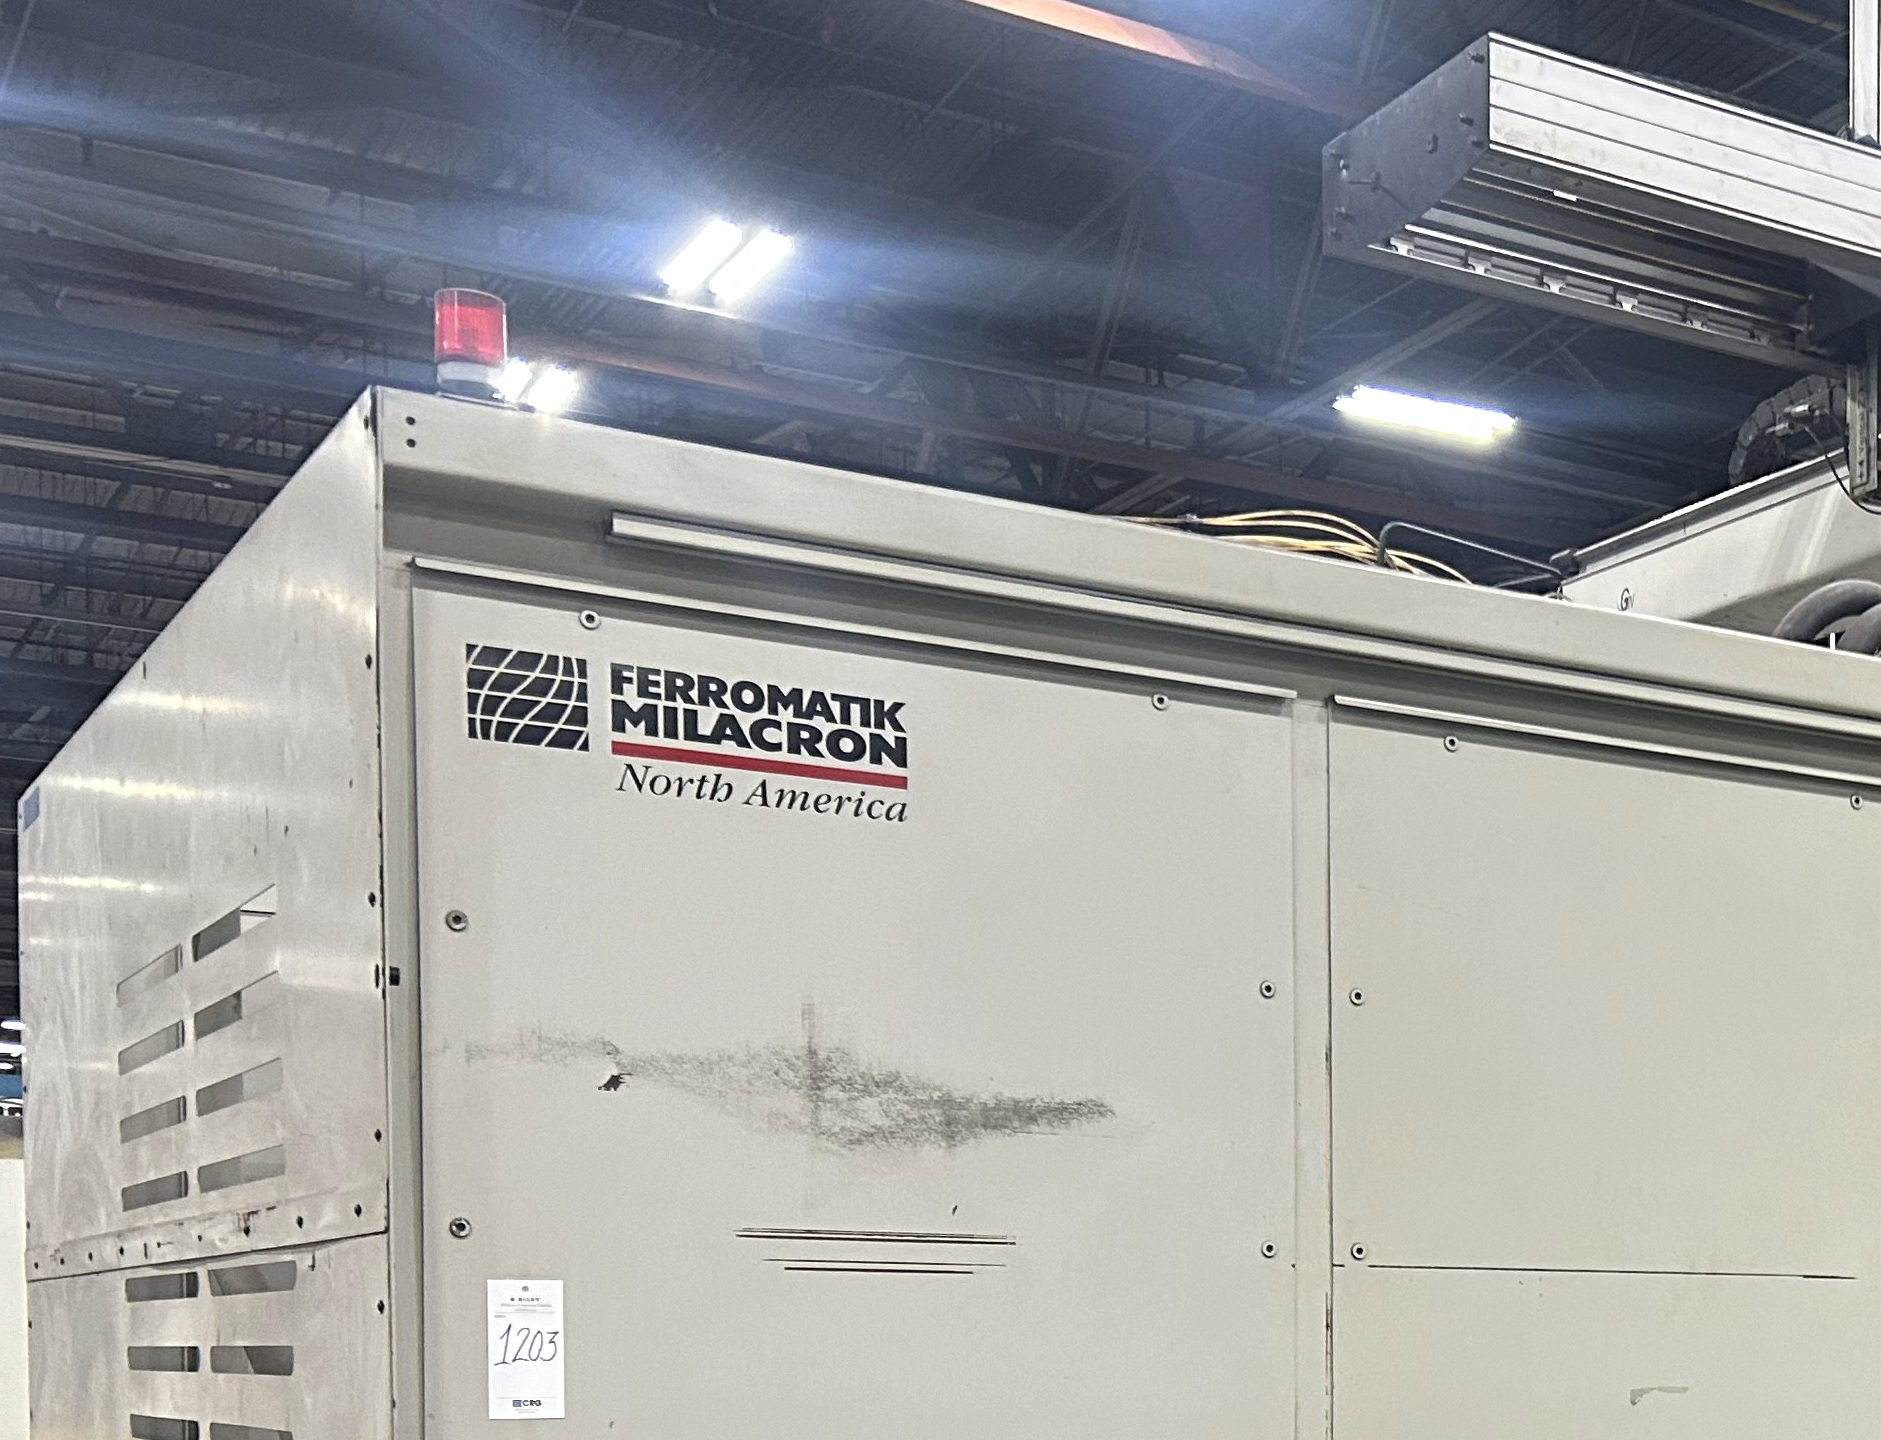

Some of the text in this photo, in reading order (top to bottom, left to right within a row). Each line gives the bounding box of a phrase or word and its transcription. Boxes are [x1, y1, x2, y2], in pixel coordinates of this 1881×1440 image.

[610, 662, 908, 734] FERROMATIK
[611, 700, 908, 770] MILACRON
[615, 763, 909, 823] North America
[494, 1323, 560, 1366] 1203
